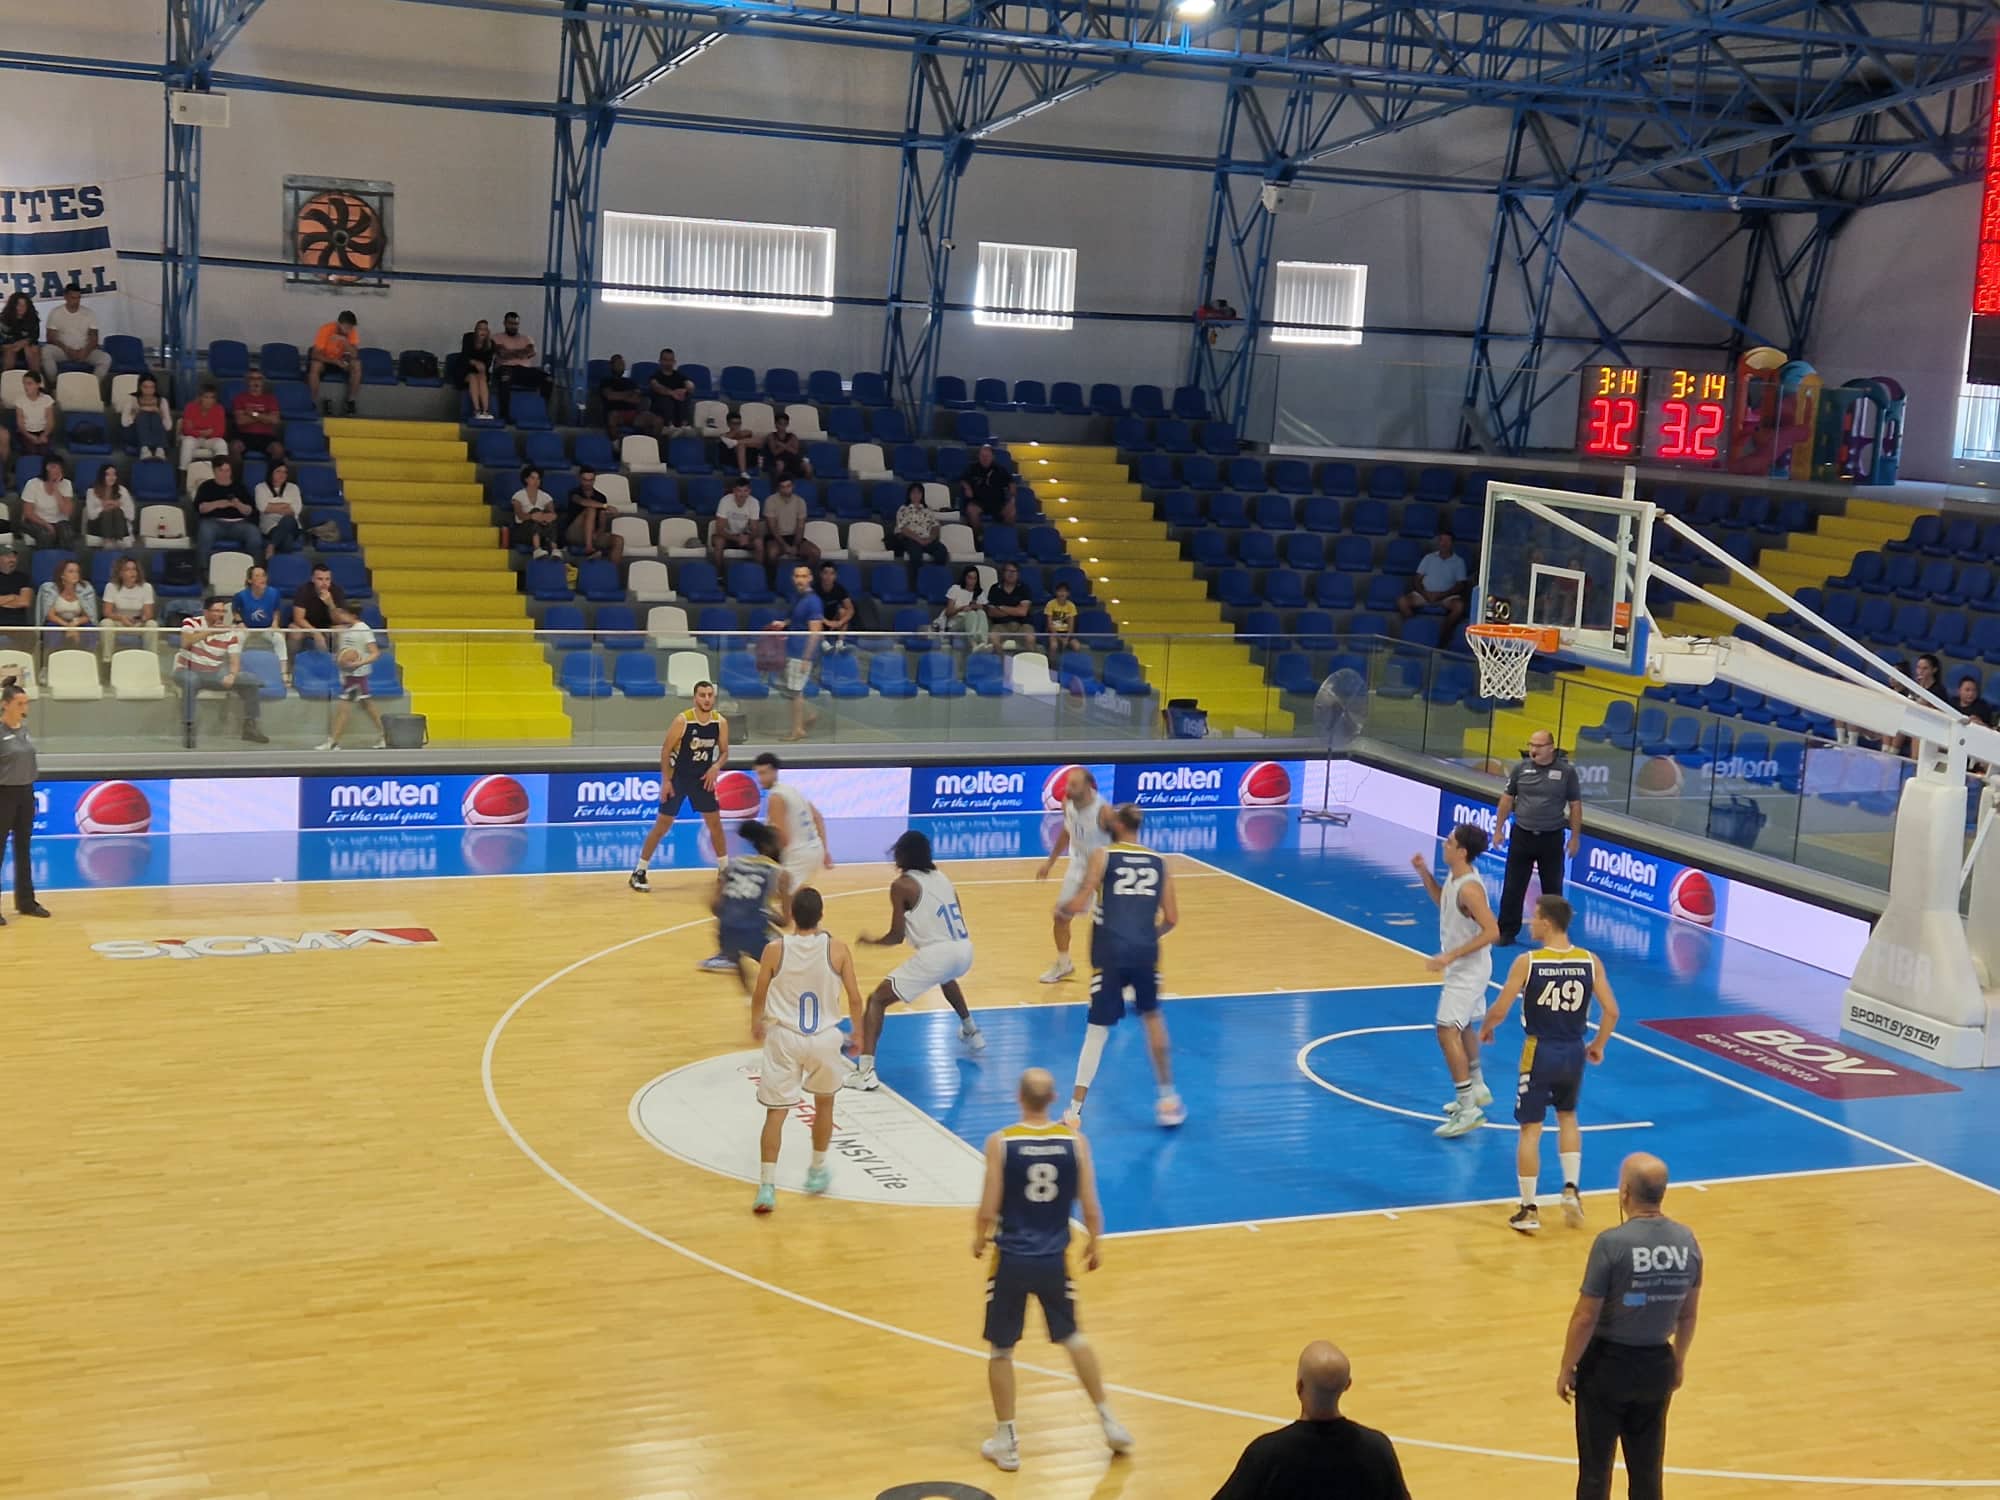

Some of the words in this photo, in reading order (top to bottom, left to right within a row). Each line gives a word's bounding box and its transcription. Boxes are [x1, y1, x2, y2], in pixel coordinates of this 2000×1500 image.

[1599, 367, 1637, 395] 3:14
[1672, 371, 1726, 399] 3:14
[577, 777, 661, 802] molte
[935, 770, 1024, 795] molten
[1137, 767, 1221, 791] molten
[330, 781, 439, 807] molten
[931, 797, 951, 809] For
[950, 797, 969, 808] the
[1134, 792, 1152, 805] For
[1151, 791, 1169, 803] the
[326, 810, 350, 823] For
[350, 809, 372, 821] the
[573, 805, 596, 818] For
[595, 804, 616, 816] the
[1590, 847, 1657, 887] molten
[1113, 867, 1159, 896] 22
[936, 903, 969, 941] 15
[1536, 980, 1585, 1012] 49
[799, 991, 819, 1034] 0
[1733, 1029, 1898, 1076] BOV
[862, 1165, 909, 1190] Life
[1024, 1162, 1059, 1203] 8
[1631, 1245, 1688, 1273] BOV
